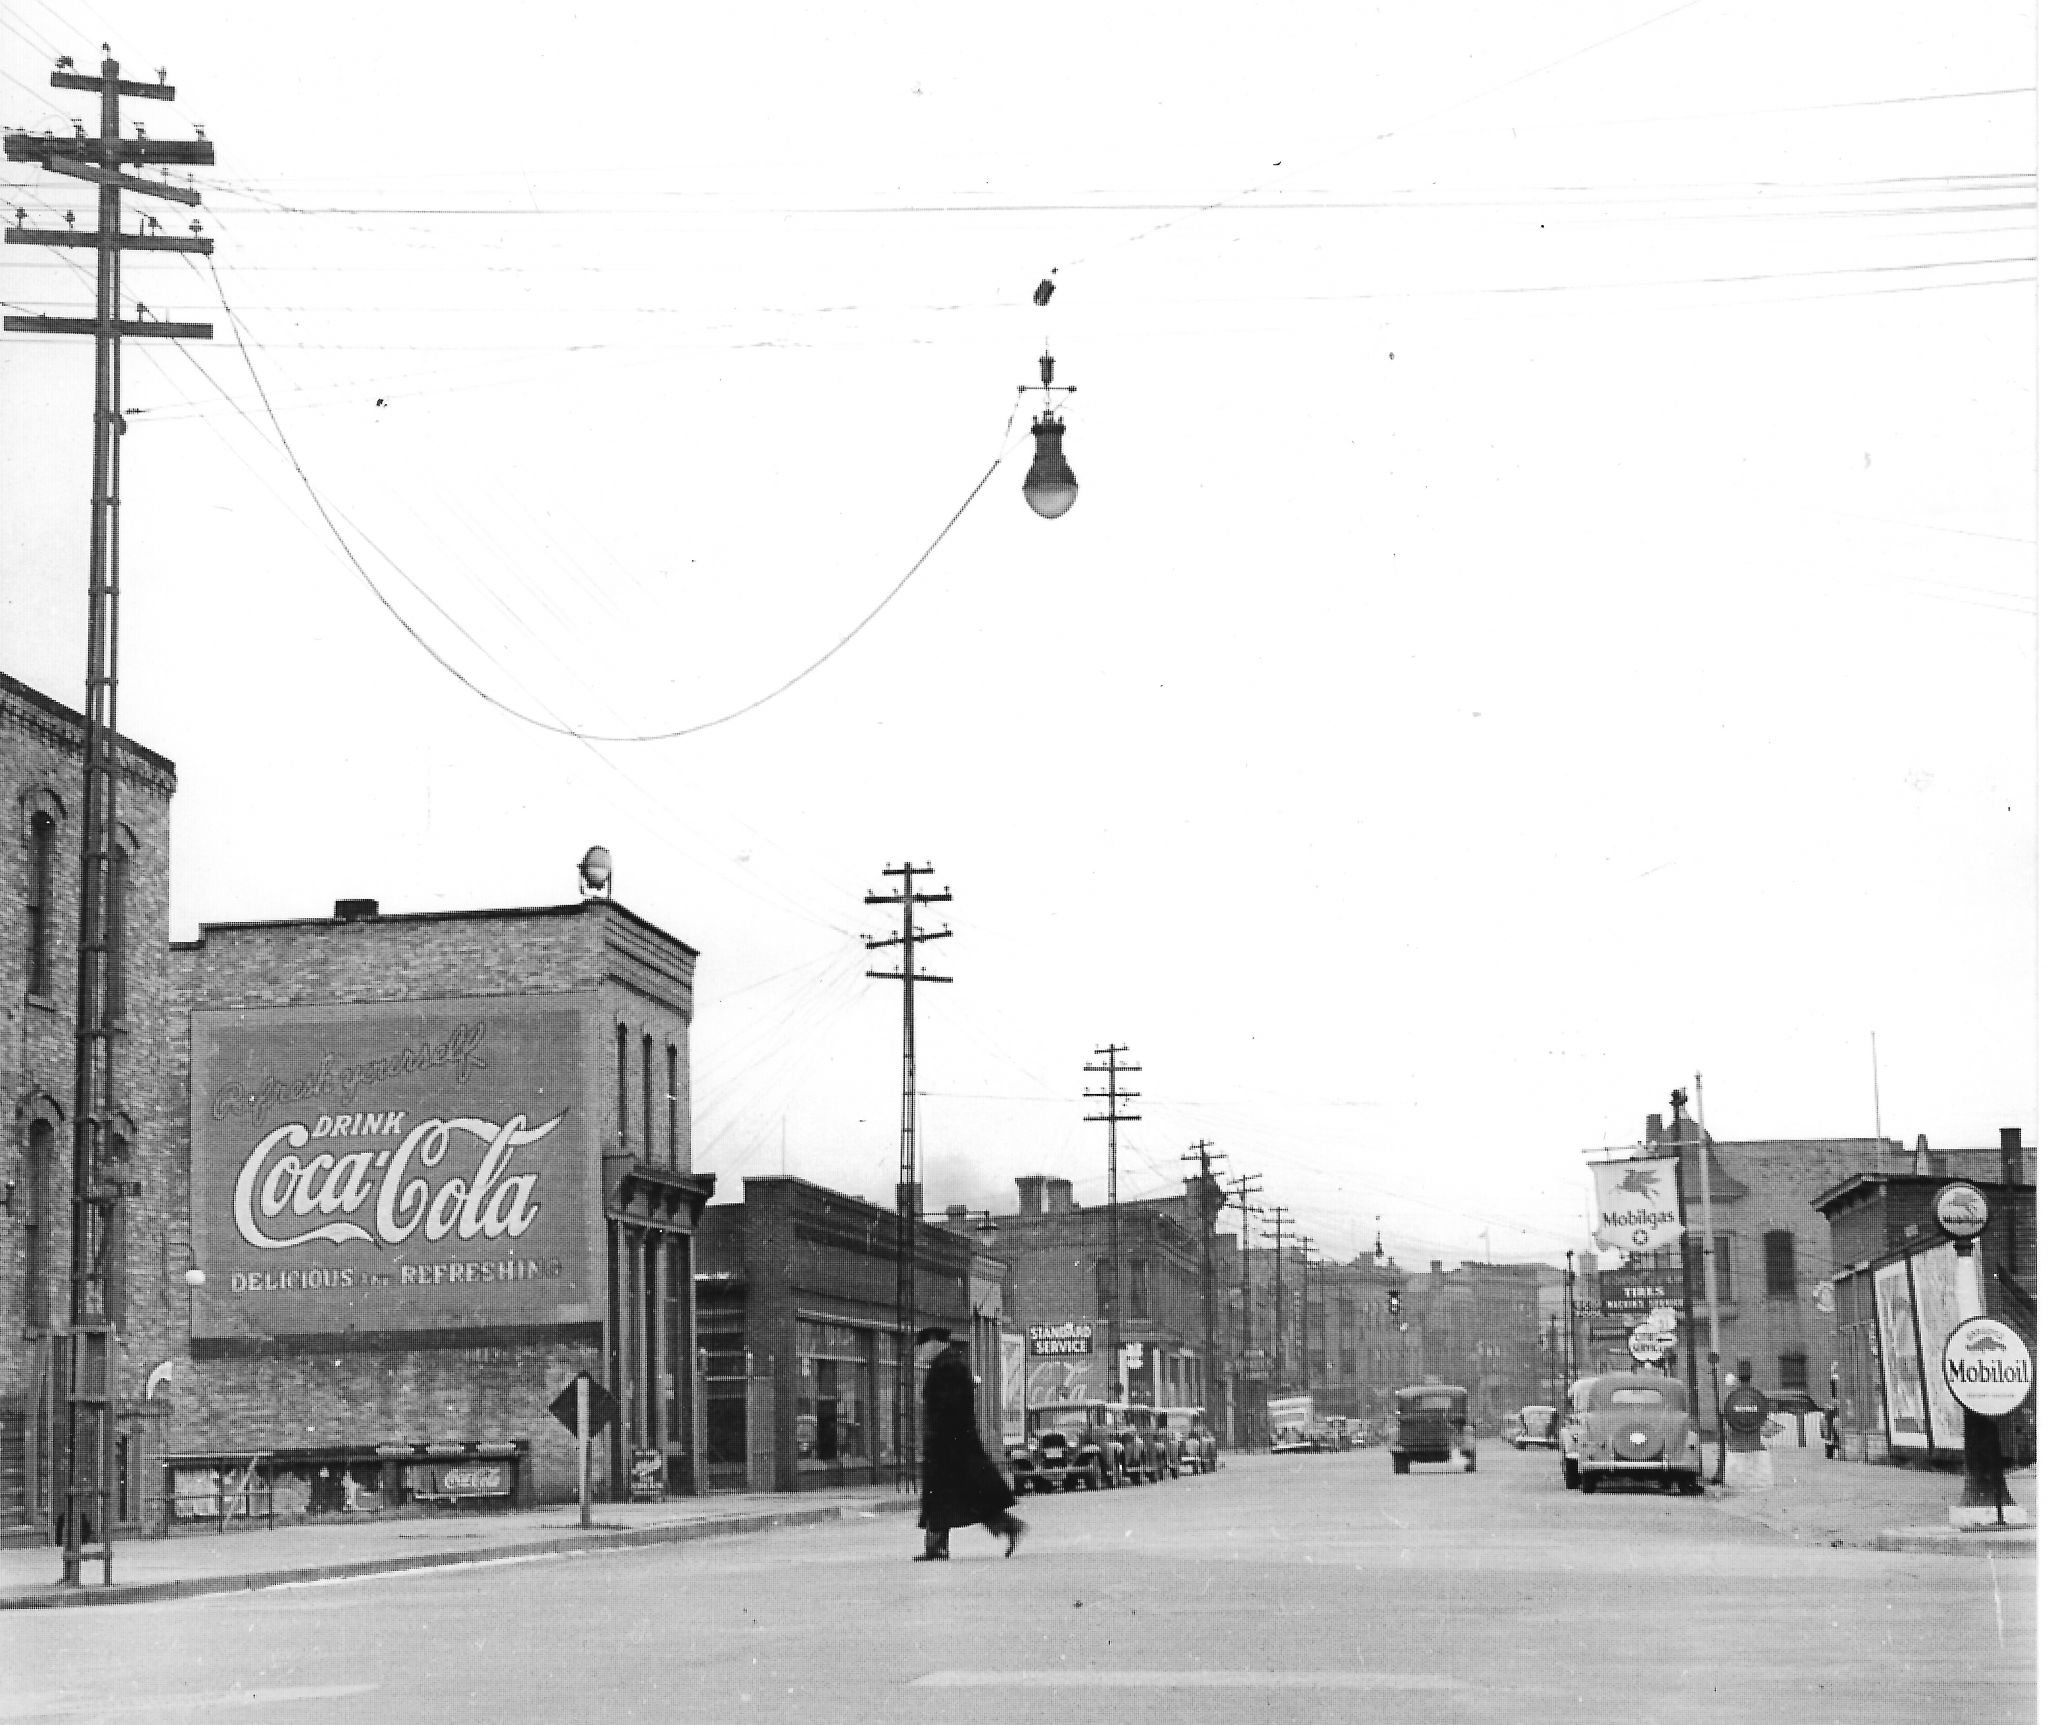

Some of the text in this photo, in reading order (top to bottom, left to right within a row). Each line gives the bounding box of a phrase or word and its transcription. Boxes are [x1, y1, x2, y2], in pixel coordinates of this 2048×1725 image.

[339, 1020, 488, 1107] yourself
[313, 1110, 407, 1138] DRINK
[232, 1106, 570, 1250] Coca-Cola
[1602, 1208, 1675, 1230] Mobilgas
[230, 1267, 354, 1294] DELICIOUS
[400, 1259, 563, 1286] REFRESHING
[1029, 1325, 1092, 1340] STANDARD
[1035, 1340, 1088, 1354] SERVICE
[1948, 1358, 2031, 1383] Mobiloil
